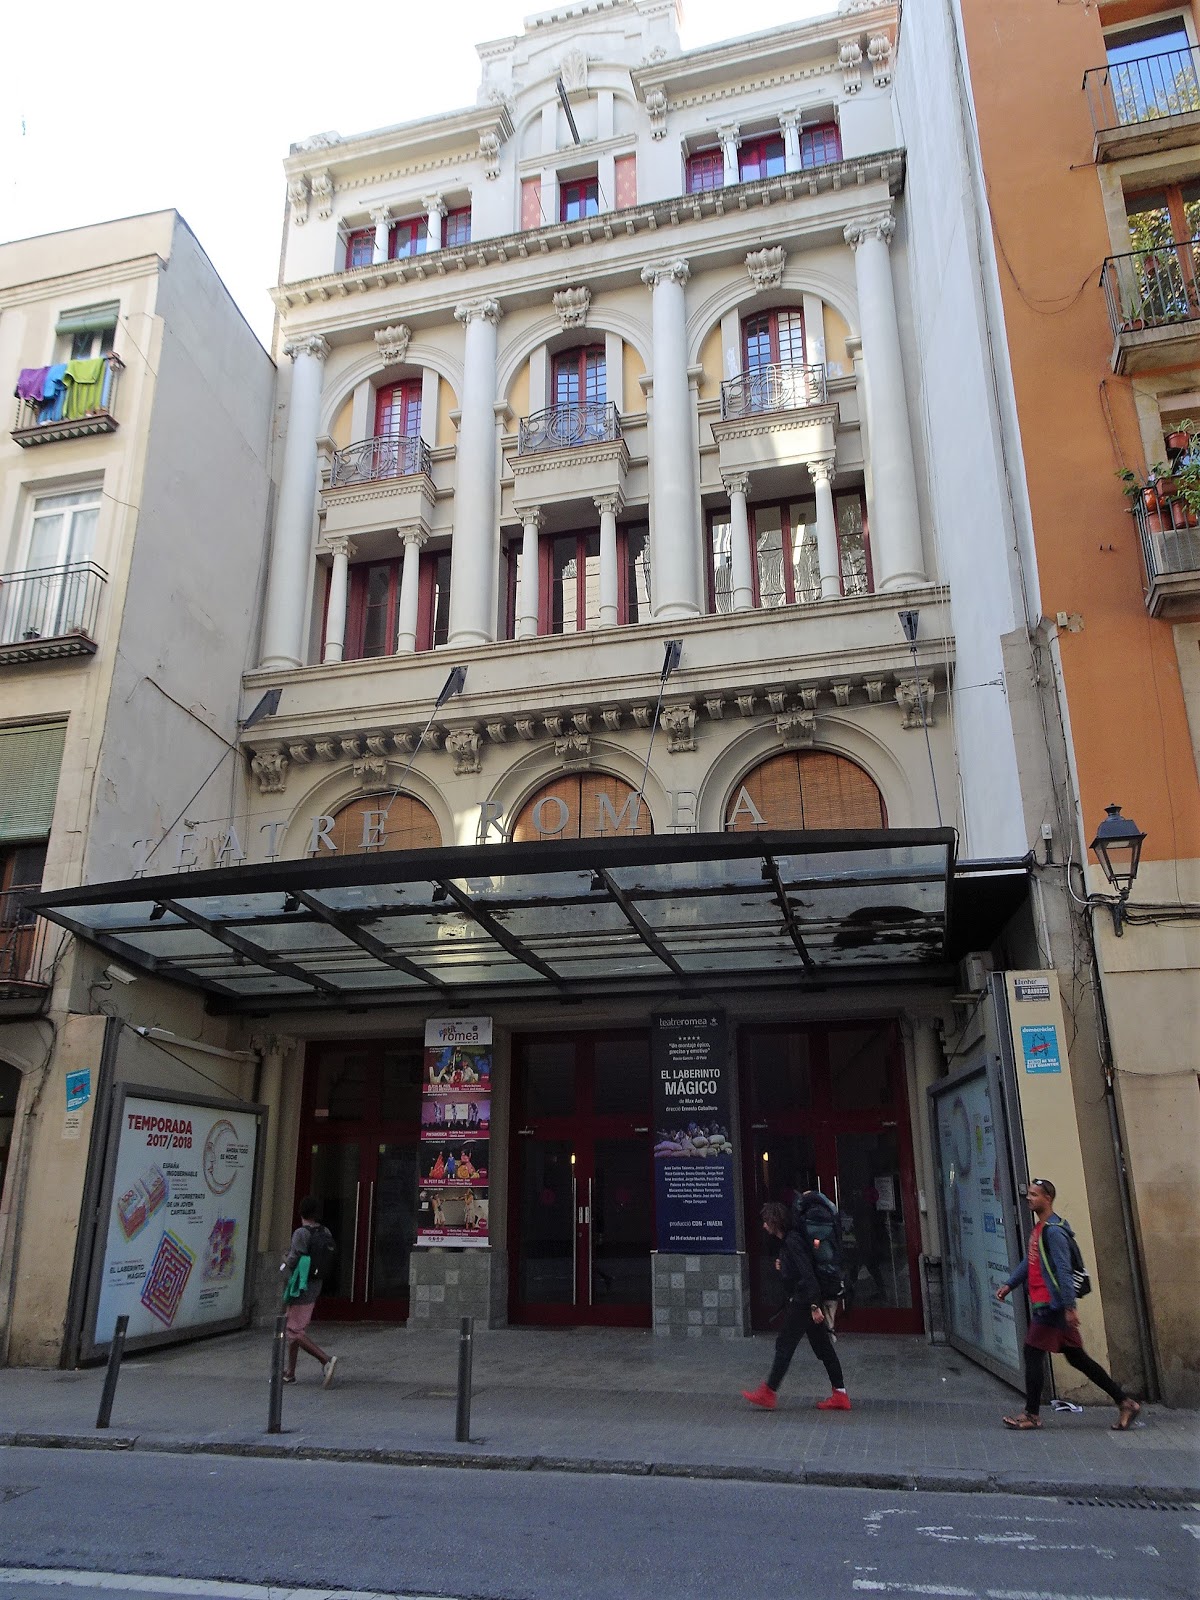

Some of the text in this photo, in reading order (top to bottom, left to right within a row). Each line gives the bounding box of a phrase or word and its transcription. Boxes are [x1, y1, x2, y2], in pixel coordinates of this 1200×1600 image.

[132, 786, 768, 872] TEATRE ROMEA
[443, 1032, 479, 1041] romea
[661, 1068, 720, 1079] EL LABERINTO
[665, 1078, 718, 1095] MÁGICO
[128, 1114, 193, 1136] TEMPORADA
[147, 1134, 193, 1150] 2017/2018
